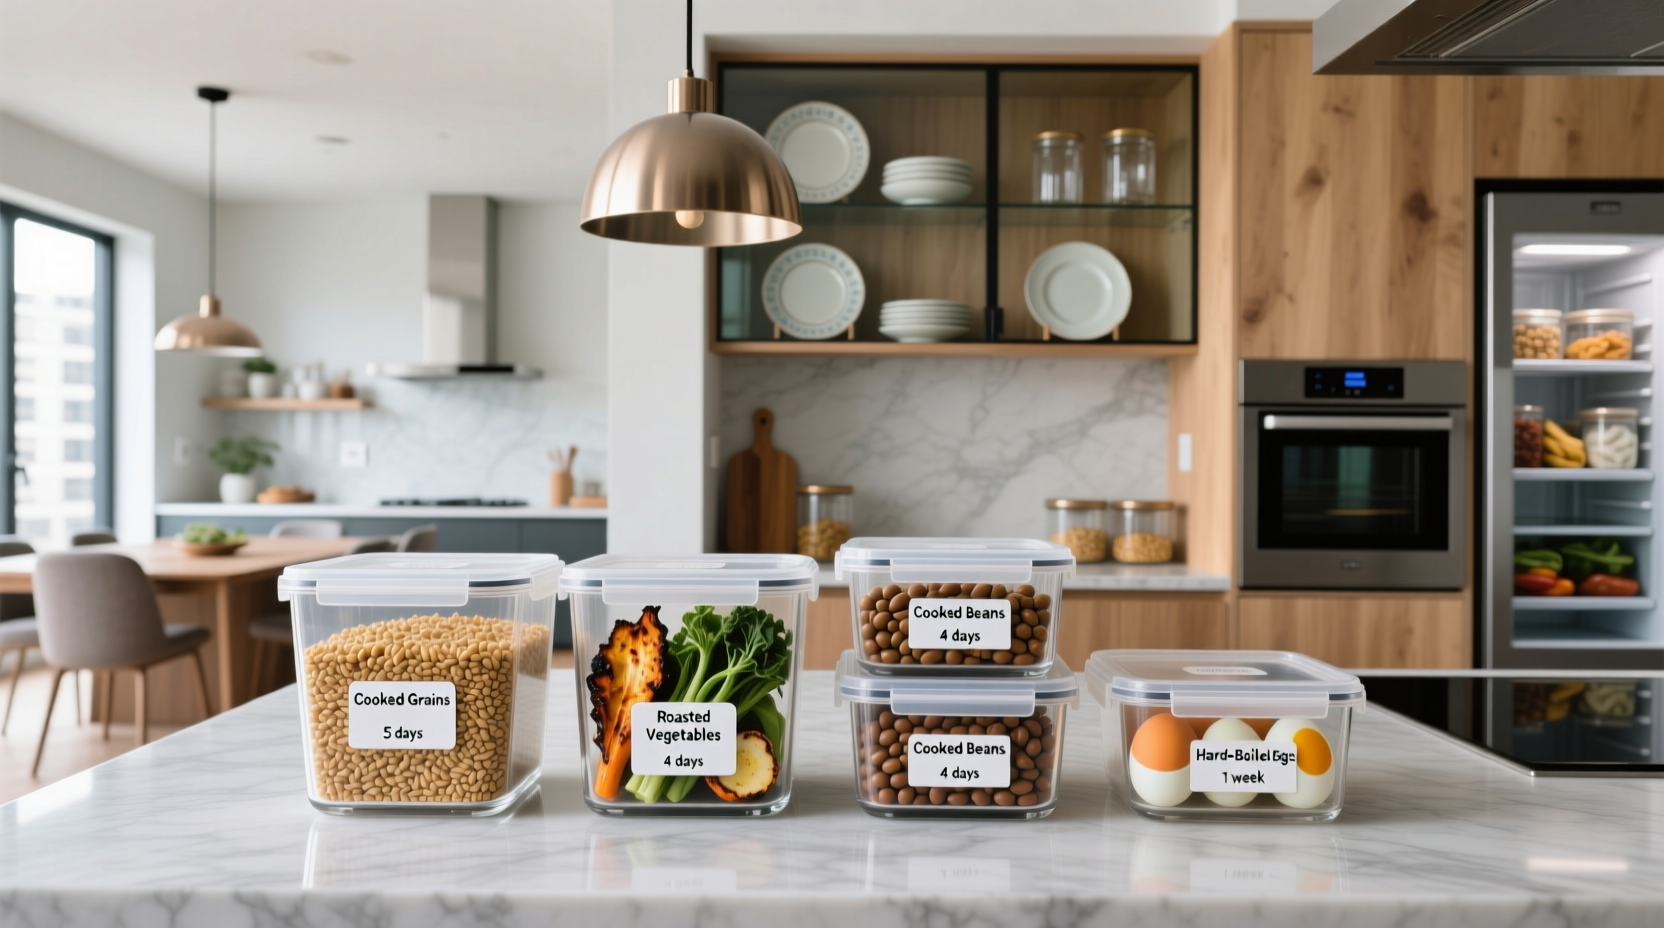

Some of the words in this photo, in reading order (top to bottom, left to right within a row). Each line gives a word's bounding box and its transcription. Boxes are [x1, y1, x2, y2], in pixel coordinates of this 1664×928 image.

[913, 605, 963, 619] Cooked
[966, 605, 1006, 620] Beans
[939, 628, 948, 642] 4
[951, 628, 981, 646] days
[353, 691, 405, 706] Cooked
[407, 692, 451, 706] Grains
[657, 709, 711, 724] Roasted
[383, 726, 392, 740] 5
[394, 726, 423, 743] days
[645, 726, 721, 745] Vegetables
[913, 741, 964, 755] Cooked
[966, 741, 1007, 755] Beans
[663, 755, 672, 767] 4
[675, 753, 704, 770] days
[939, 766, 948, 779] 4
[951, 766, 980, 783] days
[1222, 771, 1229, 784] 1
[1231, 769, 1266, 784] week
